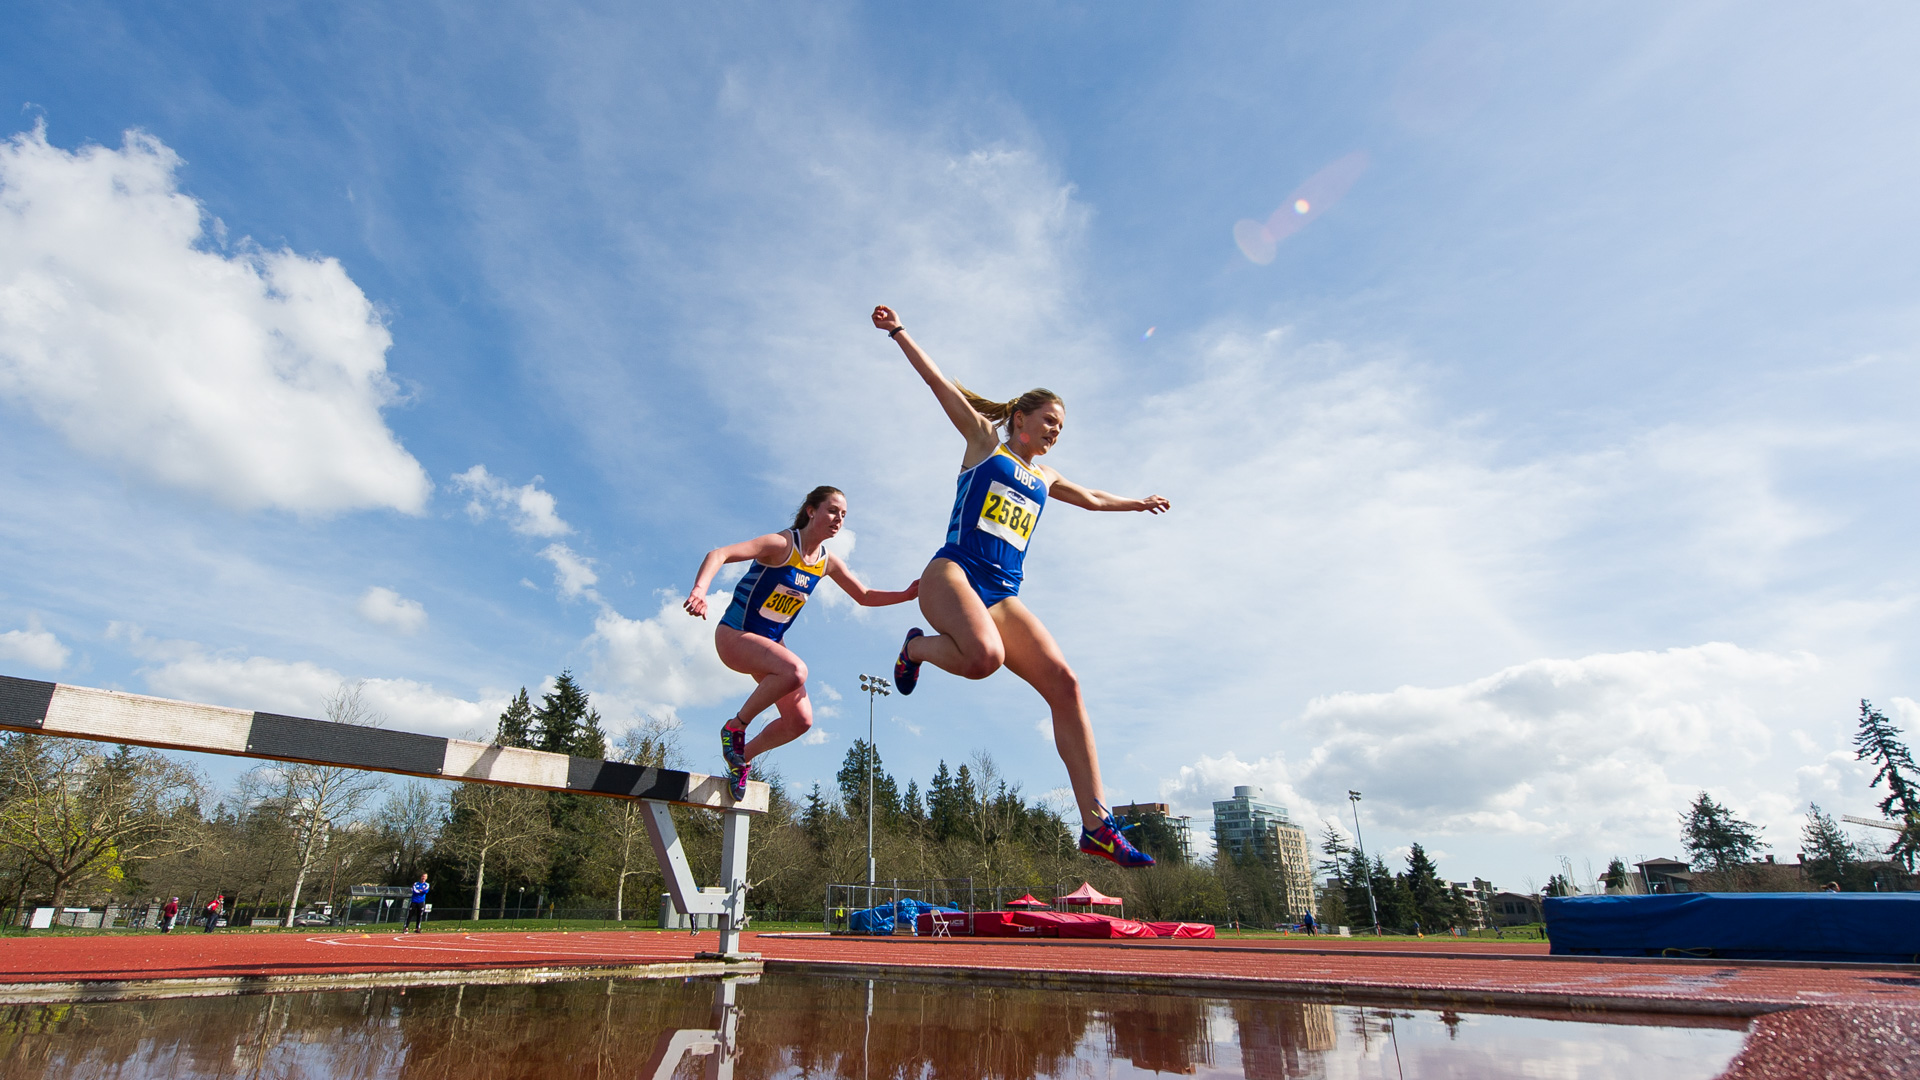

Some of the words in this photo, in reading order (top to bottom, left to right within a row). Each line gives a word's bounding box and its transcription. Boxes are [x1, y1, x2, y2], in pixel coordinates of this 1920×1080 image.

[1014, 465, 1036, 490] UBC
[984, 494, 1032, 537] 2584
[794, 572, 810, 588] UBC
[765, 593, 802, 614] 3007
